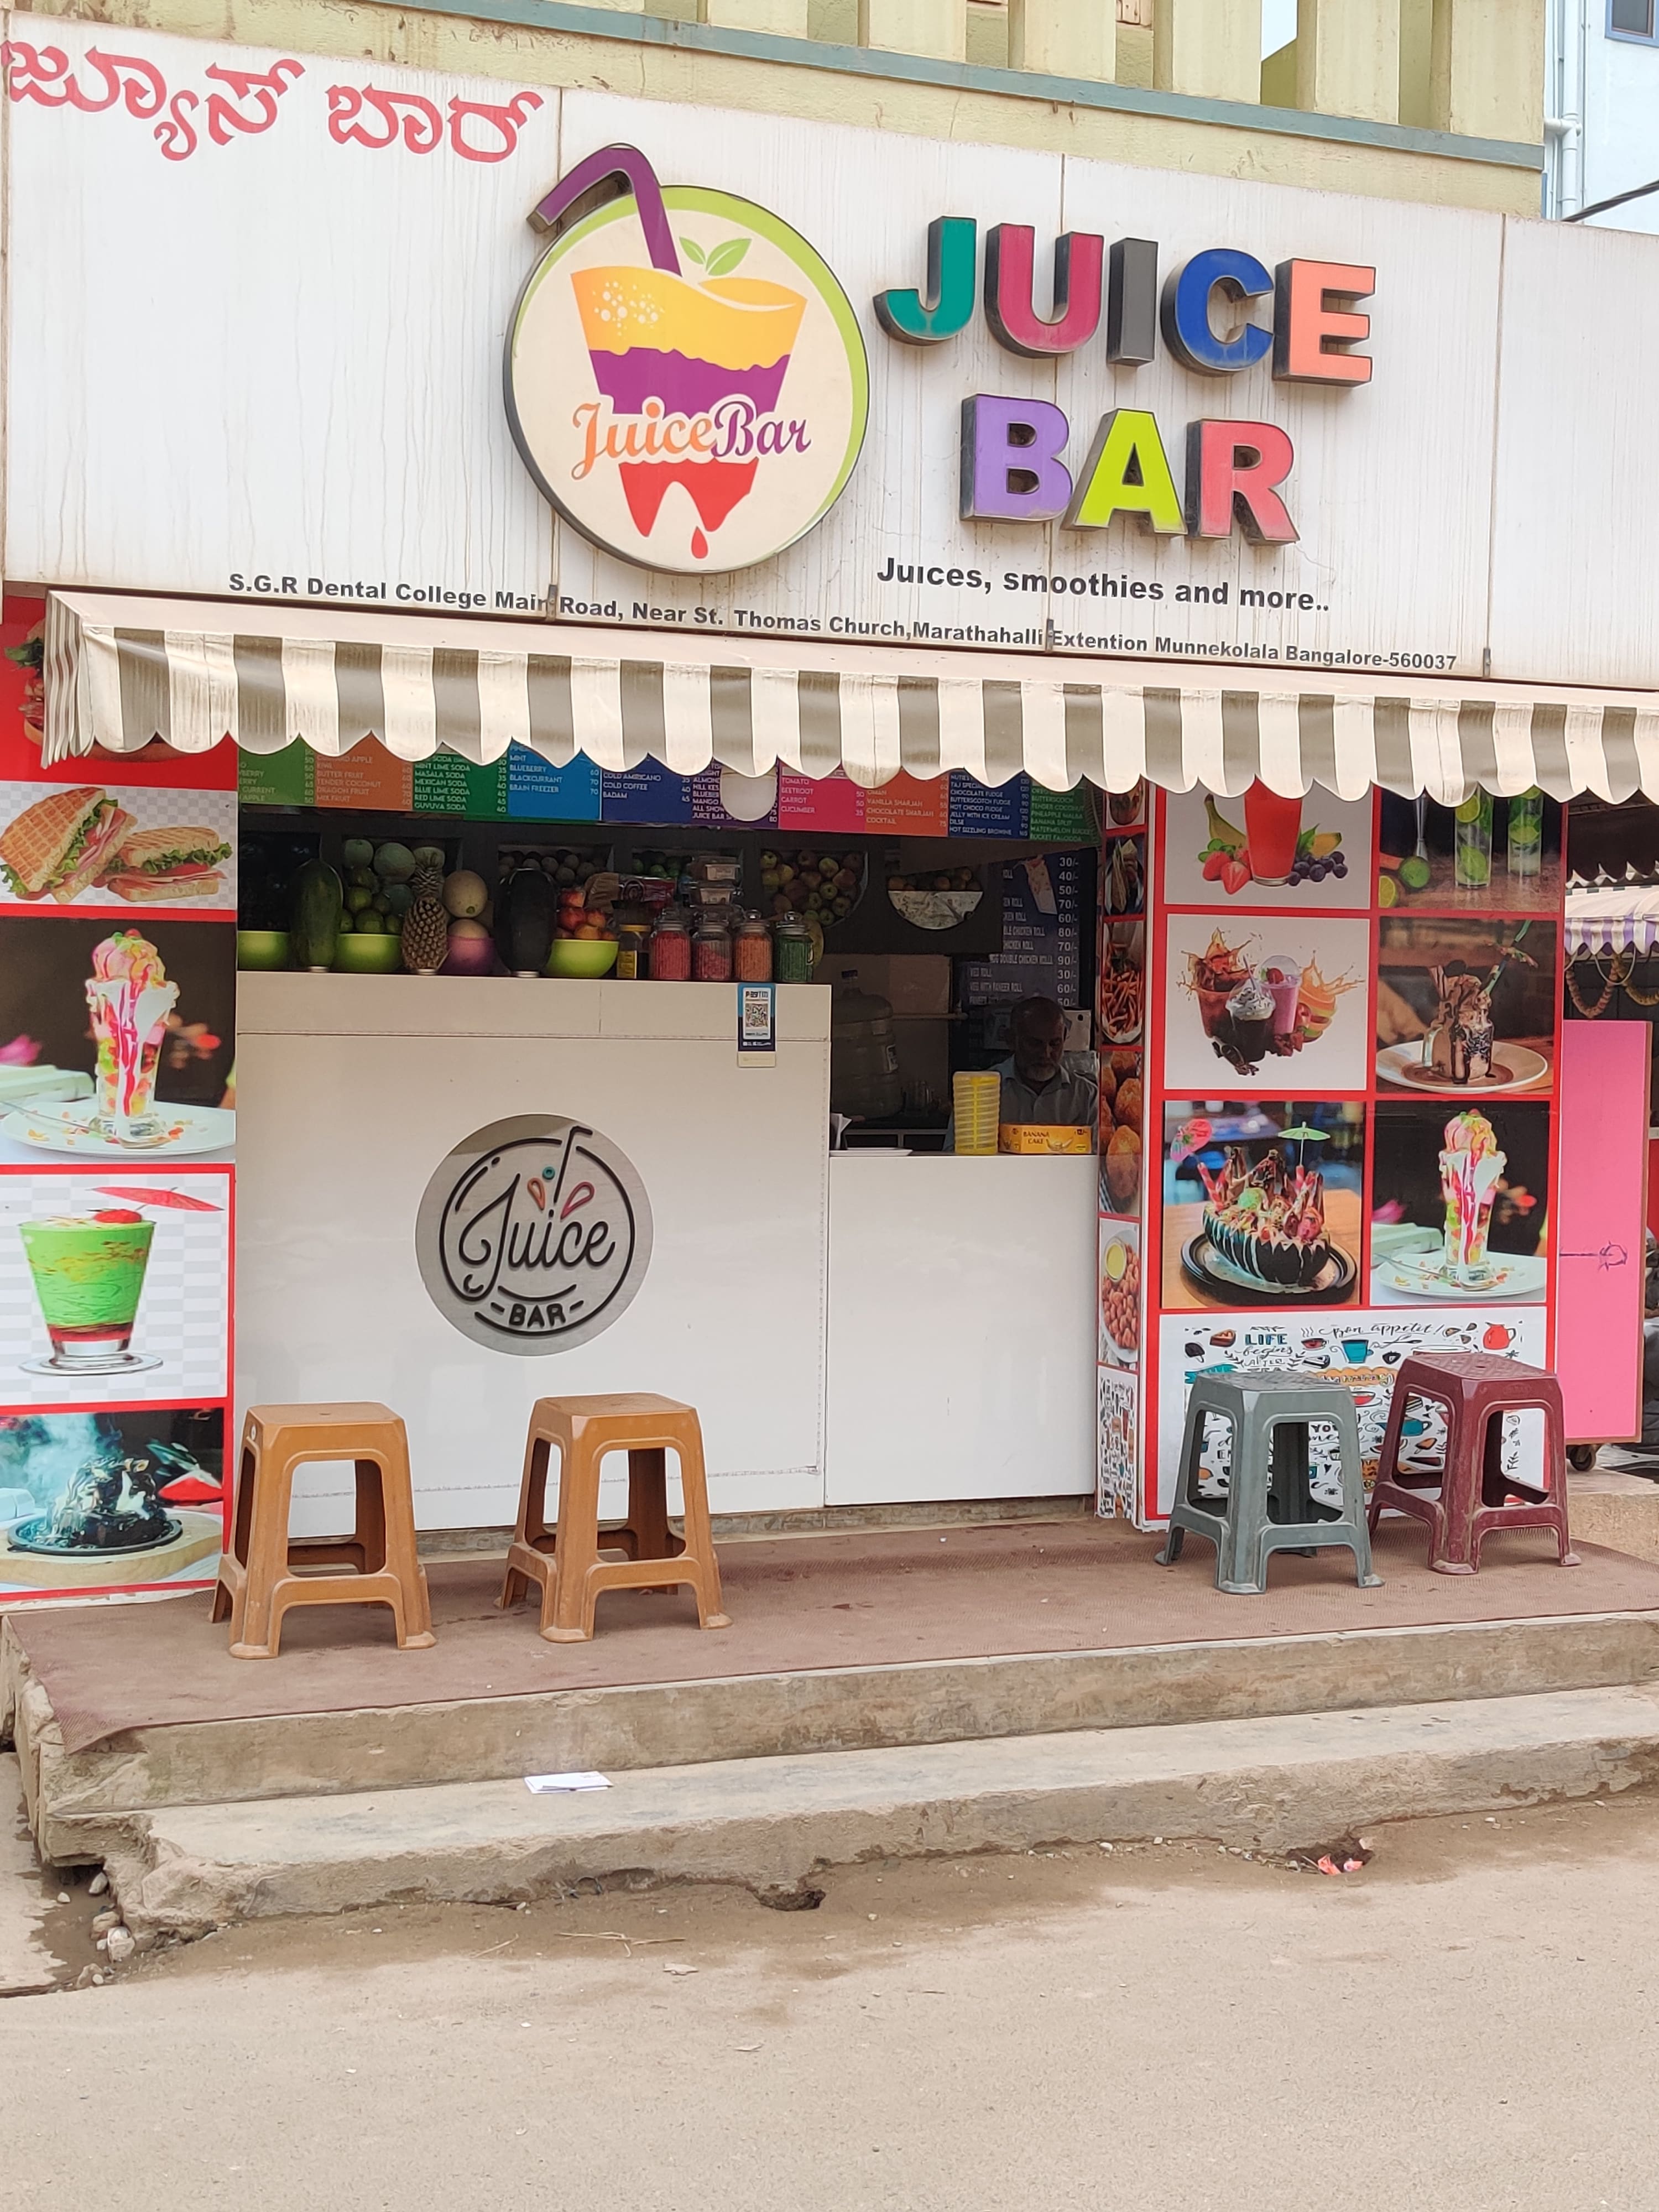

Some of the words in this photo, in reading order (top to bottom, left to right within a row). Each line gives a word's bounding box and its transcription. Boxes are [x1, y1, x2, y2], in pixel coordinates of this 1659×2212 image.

[1, 39, 305, 161] ಜ್ಯೂಸ್
[325, 82, 544, 163] ಬಾರ್
[873, 216, 1376, 387] JUICE
[960, 394, 1300, 546] BAR
[877, 557, 990, 594] Juices,
[1003, 569, 1164, 602] smoothies
[1175, 582, 1228, 606] and
[1239, 590, 1328, 612] more..
[229, 573, 298, 594] S.G.R
[307, 577, 386, 599] Dental
[395, 583, 487, 609] College
[560, 597, 623, 620] Road,
[632, 602, 686, 623] Near
[693, 606, 723, 625] St.
[734, 609, 821, 632] Thomas
[1053, 630, 1147, 651] Extention
[1155, 635, 1279, 660] Munnekolala
[1286, 644, 1457, 671] Bangalore-560037
[509, 764, 547, 773] BLUEBERRY
[623, 782, 648, 791] COFFEE
[781, 787, 815, 795] BEETROOT
[446, 796, 467, 804] SODA
[866, 807, 904, 816] CHOCOLATE
[458, 1173, 615, 1301] Juice
[509, 1303, 566, 1329] BAR
[1244, 1333, 1288, 1345] LIFE
[1242, 1346, 1293, 1359] begins
